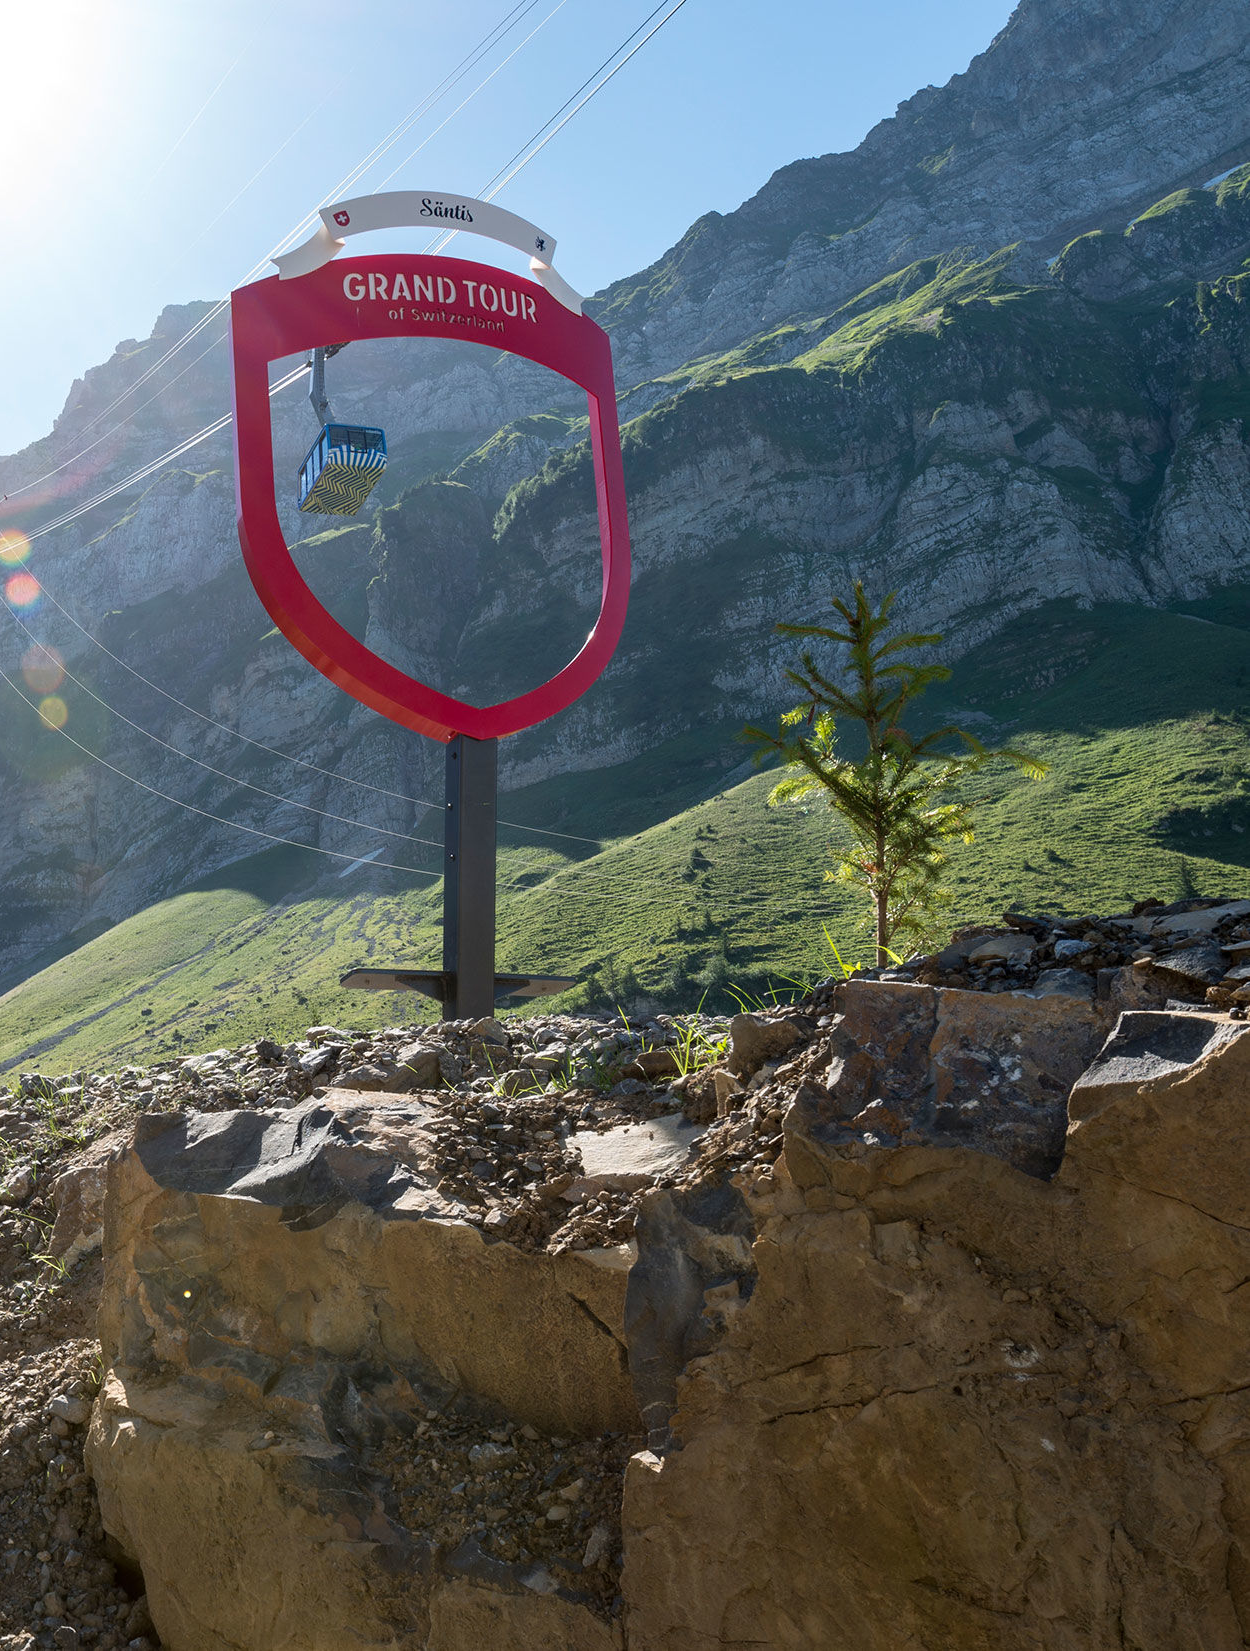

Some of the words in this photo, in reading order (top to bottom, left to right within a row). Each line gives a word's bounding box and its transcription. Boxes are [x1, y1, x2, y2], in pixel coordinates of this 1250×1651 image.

[420, 198, 473, 223] Säntis
[343, 273, 457, 304] GRAND
[462, 280, 537, 323] TOUR
[388, 308, 405, 321] of
[411, 308, 505, 333] Switzerland
